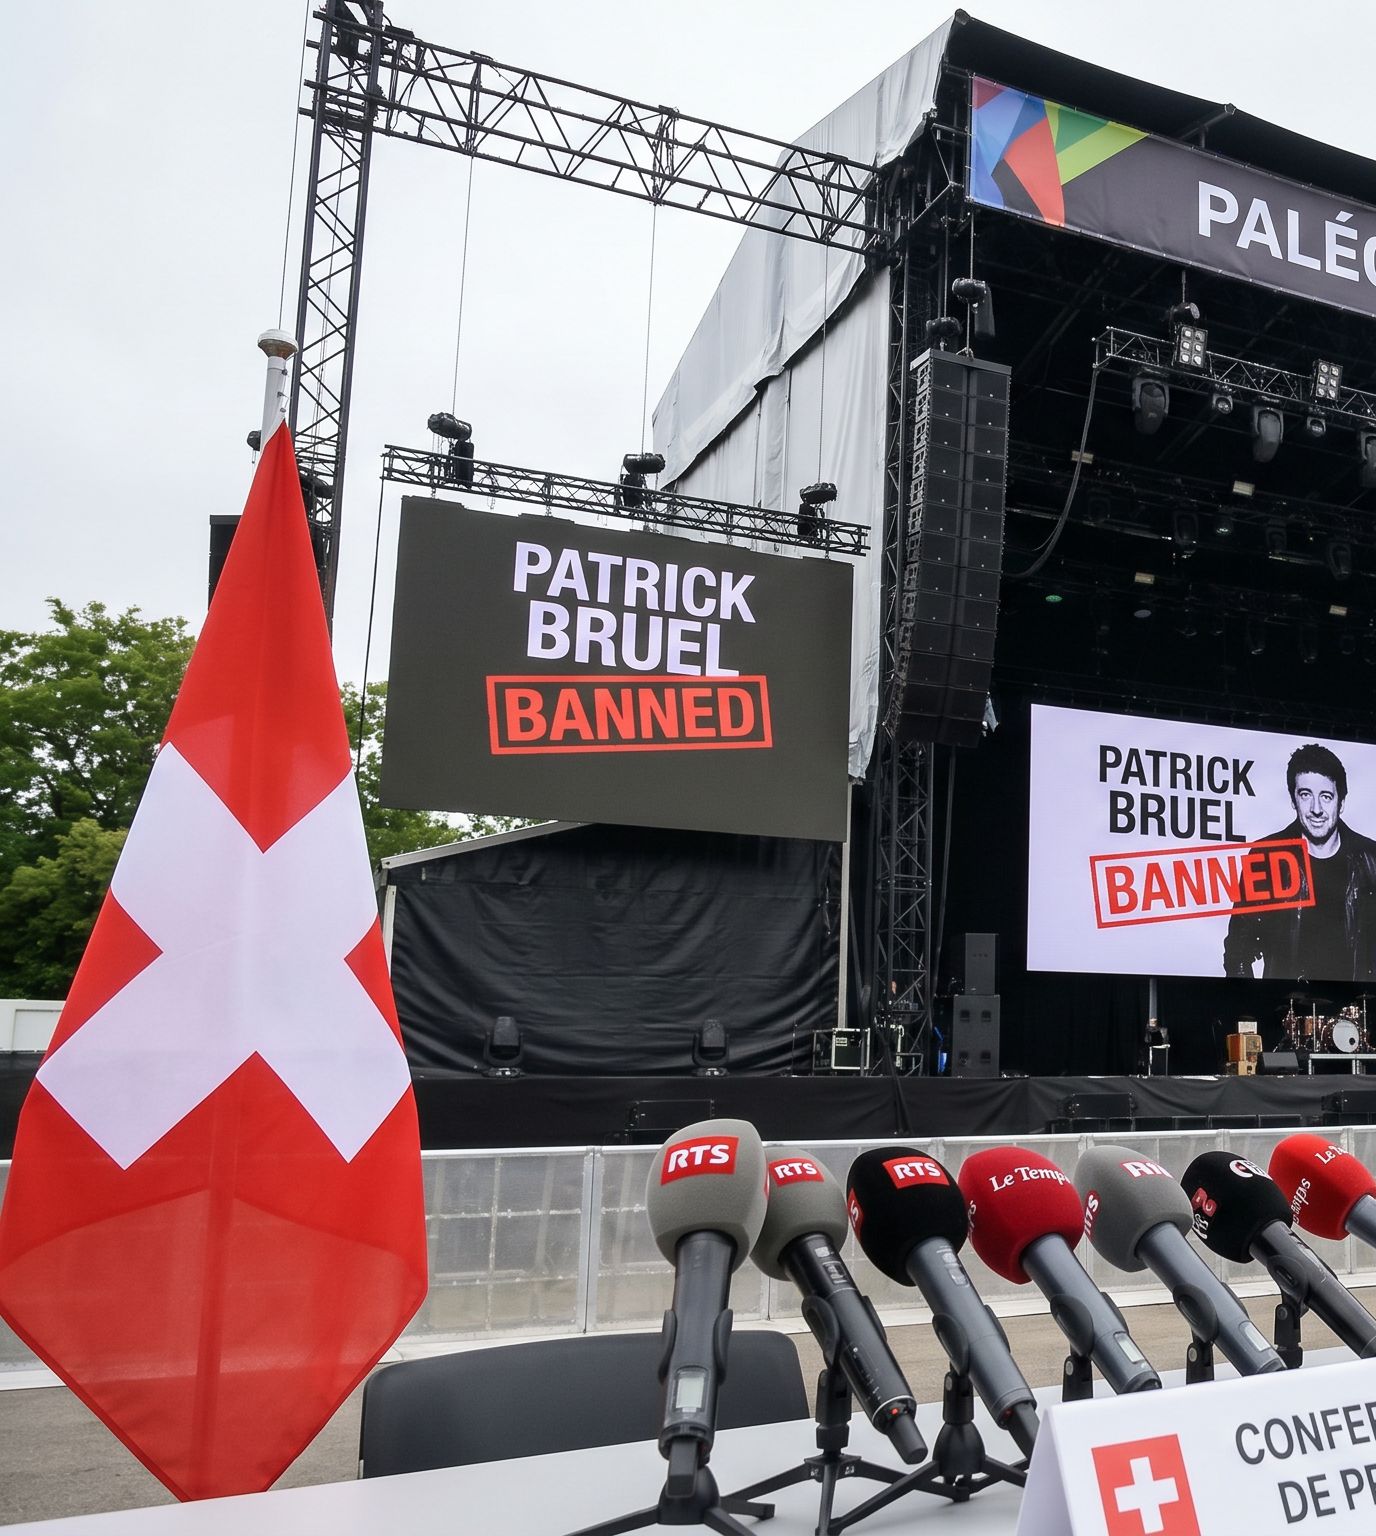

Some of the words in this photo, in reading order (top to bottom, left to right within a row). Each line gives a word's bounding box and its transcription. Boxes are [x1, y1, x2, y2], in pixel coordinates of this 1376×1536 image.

[513, 541, 756, 624] PATRICK
[527, 600, 740, 677] BRUEL
[504, 687, 755, 741] BANNED
[1099, 744, 1256, 796] PATRICK
[1109, 790, 1247, 842] BRUEL
[1105, 850, 1300, 915] BANNED
[667, 1144, 730, 1173] RTS
[774, 1162, 817, 1179] RTS
[893, 1161, 941, 1180] RTS
[989, 1175, 1015, 1192] Le
[1278, 1474, 1336, 1524] DE
